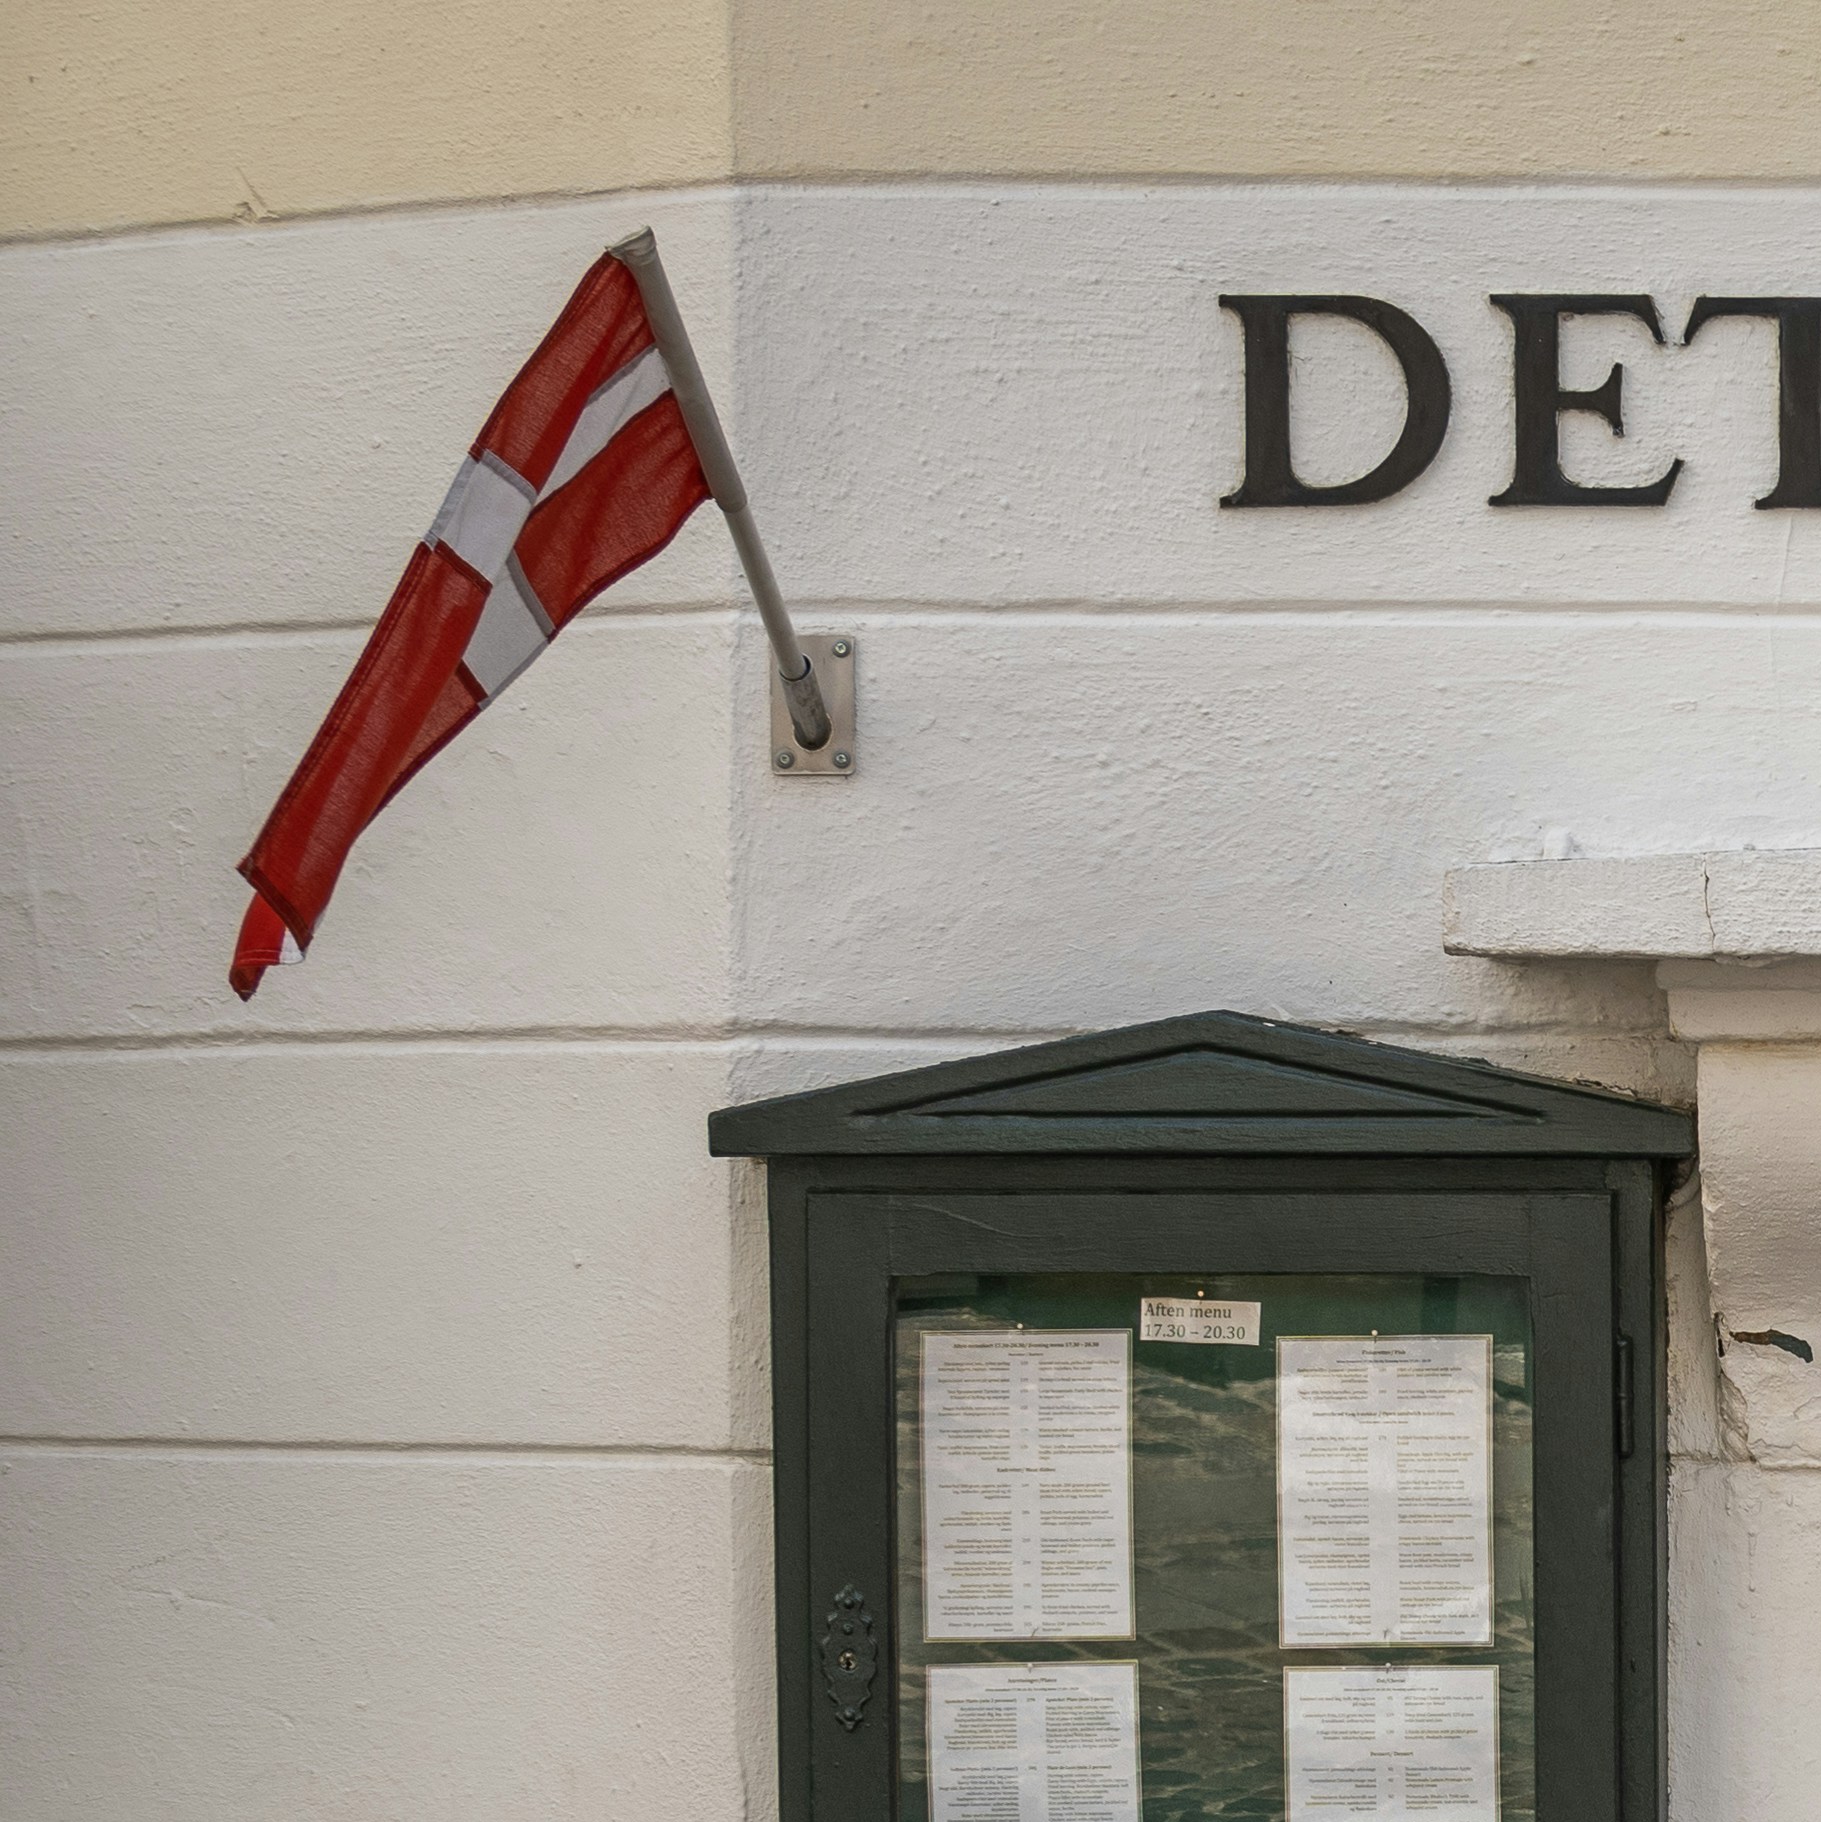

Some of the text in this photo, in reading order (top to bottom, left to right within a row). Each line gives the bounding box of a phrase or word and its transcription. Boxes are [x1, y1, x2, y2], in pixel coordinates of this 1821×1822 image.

[1144, 1302, 1232, 1319] Aften menu
[1145, 1324, 1186, 1338] 17.30
[1203, 1325, 1246, 1340] 20.30
